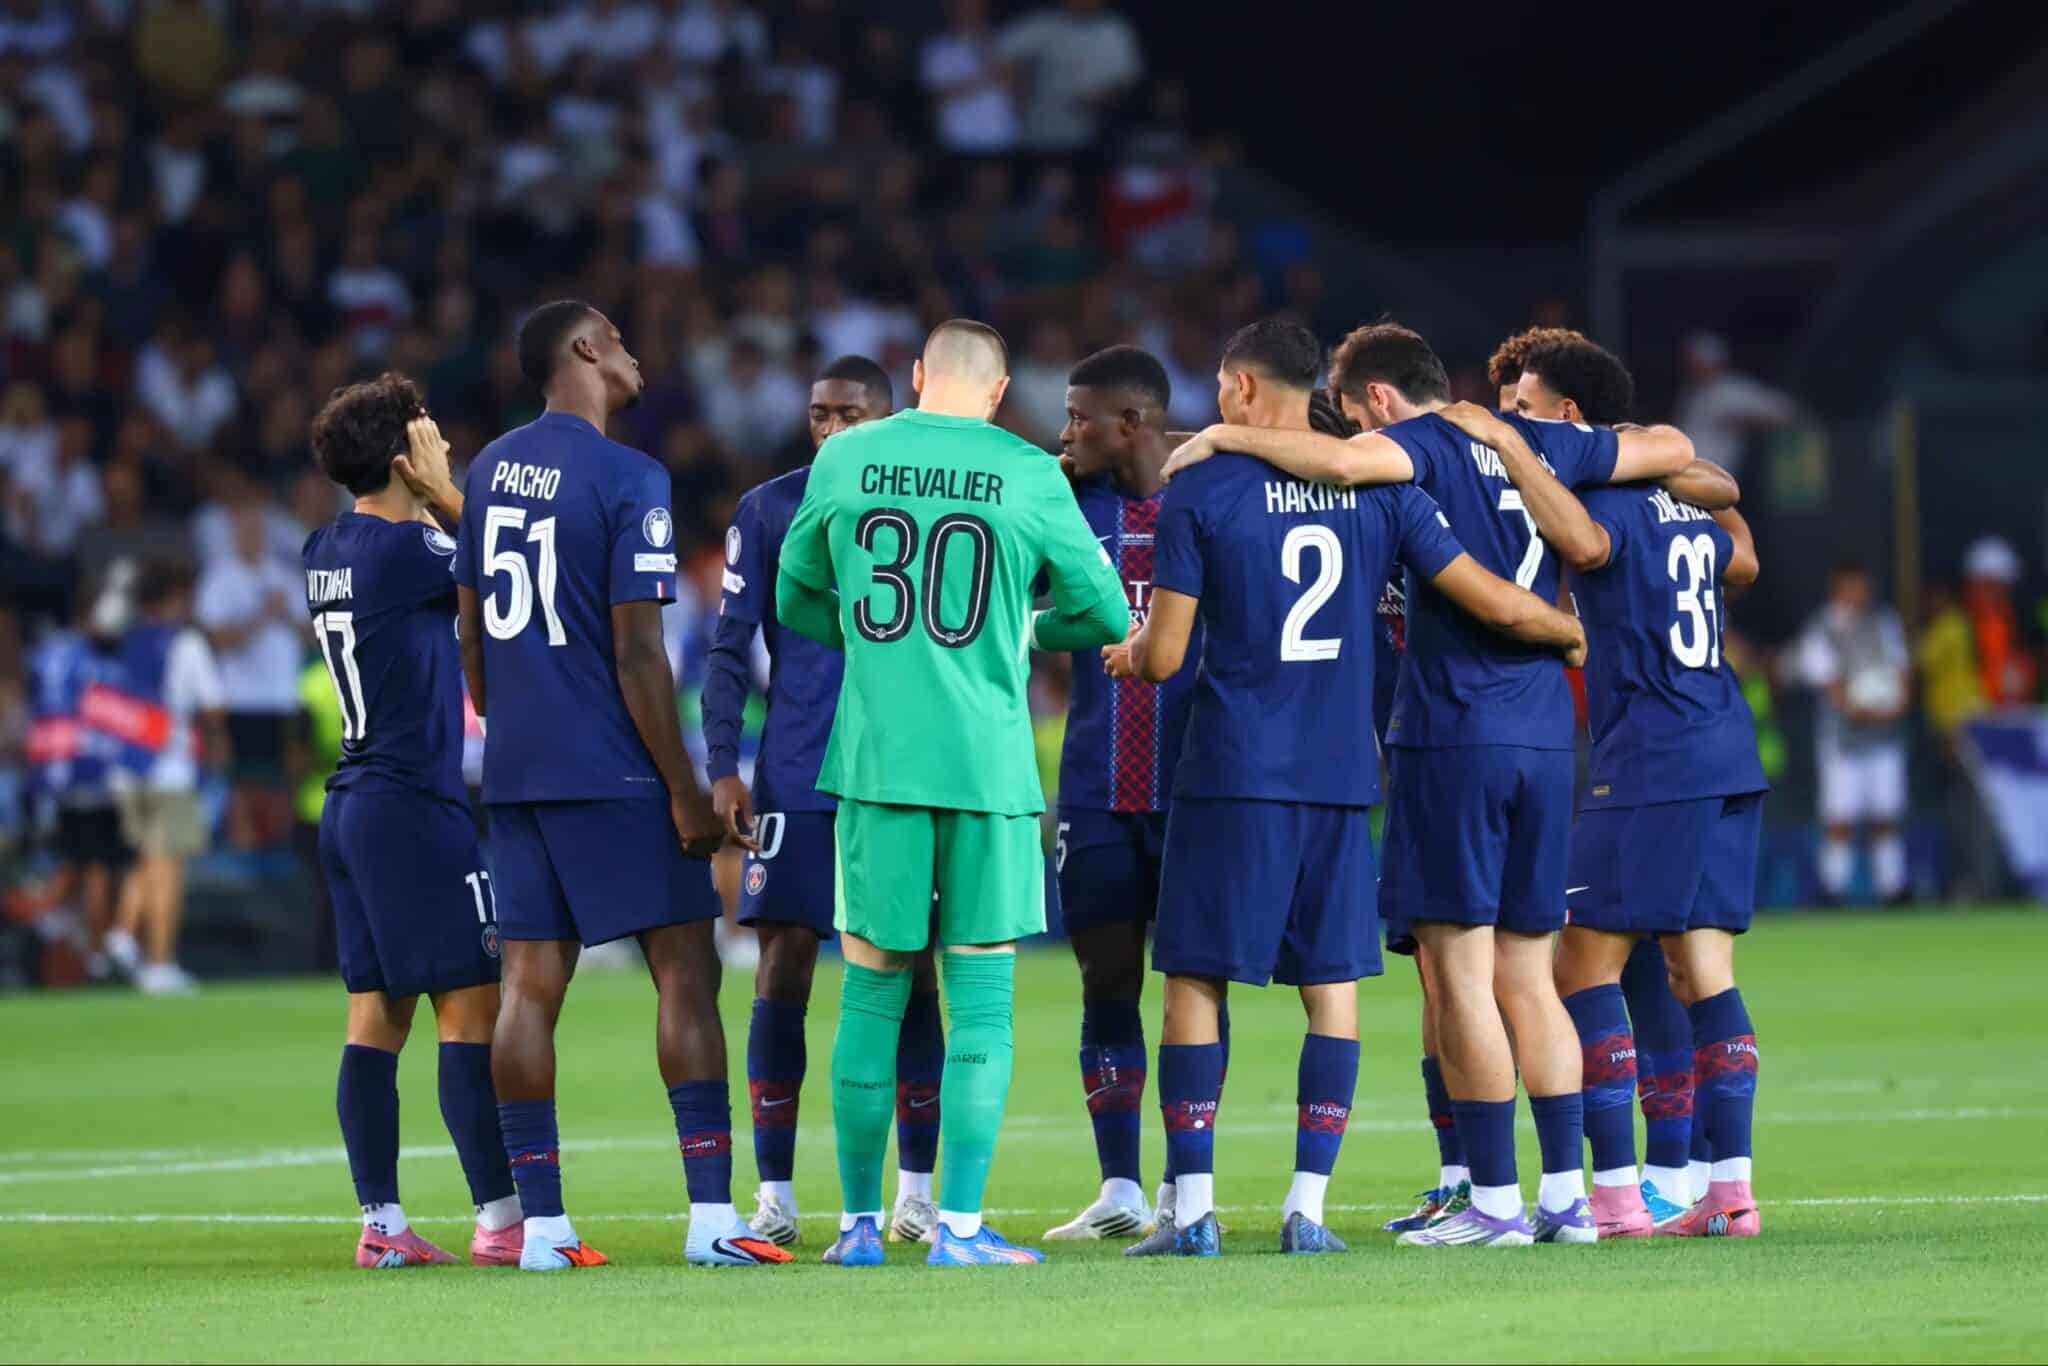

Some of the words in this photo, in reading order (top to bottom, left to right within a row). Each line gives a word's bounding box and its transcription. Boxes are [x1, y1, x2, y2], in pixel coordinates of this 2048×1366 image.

[491, 461, 561, 500] PACHO
[861, 464, 1004, 505] CHEVALIER
[1264, 481, 1358, 514] HAKIMI
[1498, 489, 1544, 592] 7
[484, 505, 568, 647] 51
[854, 507, 995, 649] 30
[1280, 524, 1344, 662] 2
[313, 611, 367, 740] 17
[1610, 1048, 1637, 1063] PAR
[1189, 1101, 1217, 1114] PAR
[1309, 1103, 1348, 1119] PARIS
